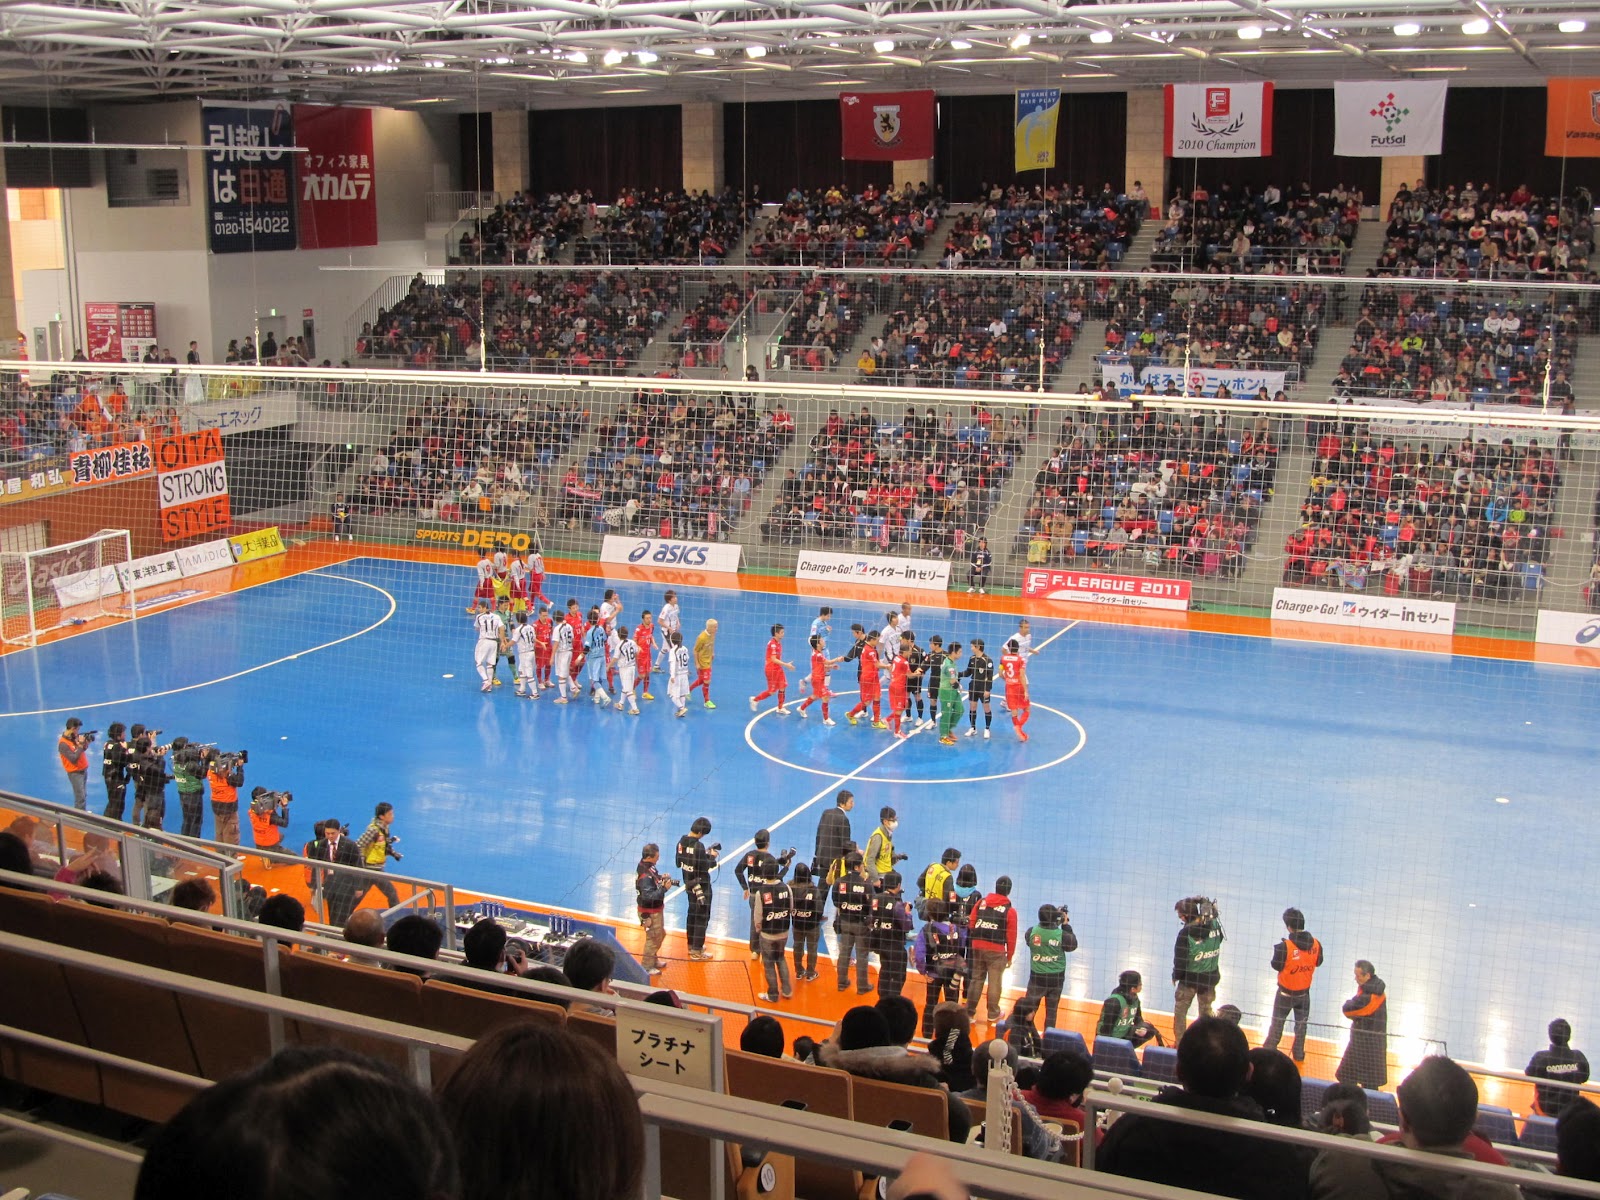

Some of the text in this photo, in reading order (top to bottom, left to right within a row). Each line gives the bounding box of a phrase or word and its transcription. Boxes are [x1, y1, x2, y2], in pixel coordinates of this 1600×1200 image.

[208, 124, 284, 162] 引越し
[1178, 138, 1256, 153] 2010 Champion
[1371, 134, 1406, 144] Futsal
[304, 154, 370, 169] オフィス家具
[302, 173, 371, 200] オカムラ
[214, 217, 290, 235] 0120-154022
[161, 432, 220, 468] OITA
[162, 465, 225, 503] STRONG
[166, 499, 228, 537] STYLE
[416, 529, 531, 551] SPORTS DEPO
[800, 561, 832, 574] Charge
[837, 563, 853, 575] Go!
[1052, 575, 1180, 596] F.LEAGUE 2011
[1275, 599, 1314, 614] Charge
[1320, 603, 1339, 615] Go!
[483, 618, 494, 632] 11
[1006, 662, 1015, 678] 3
[631, 1029, 696, 1055] プラチナ
[640, 1051, 686, 1075] シート
[763, 1168, 774, 1186] 10
